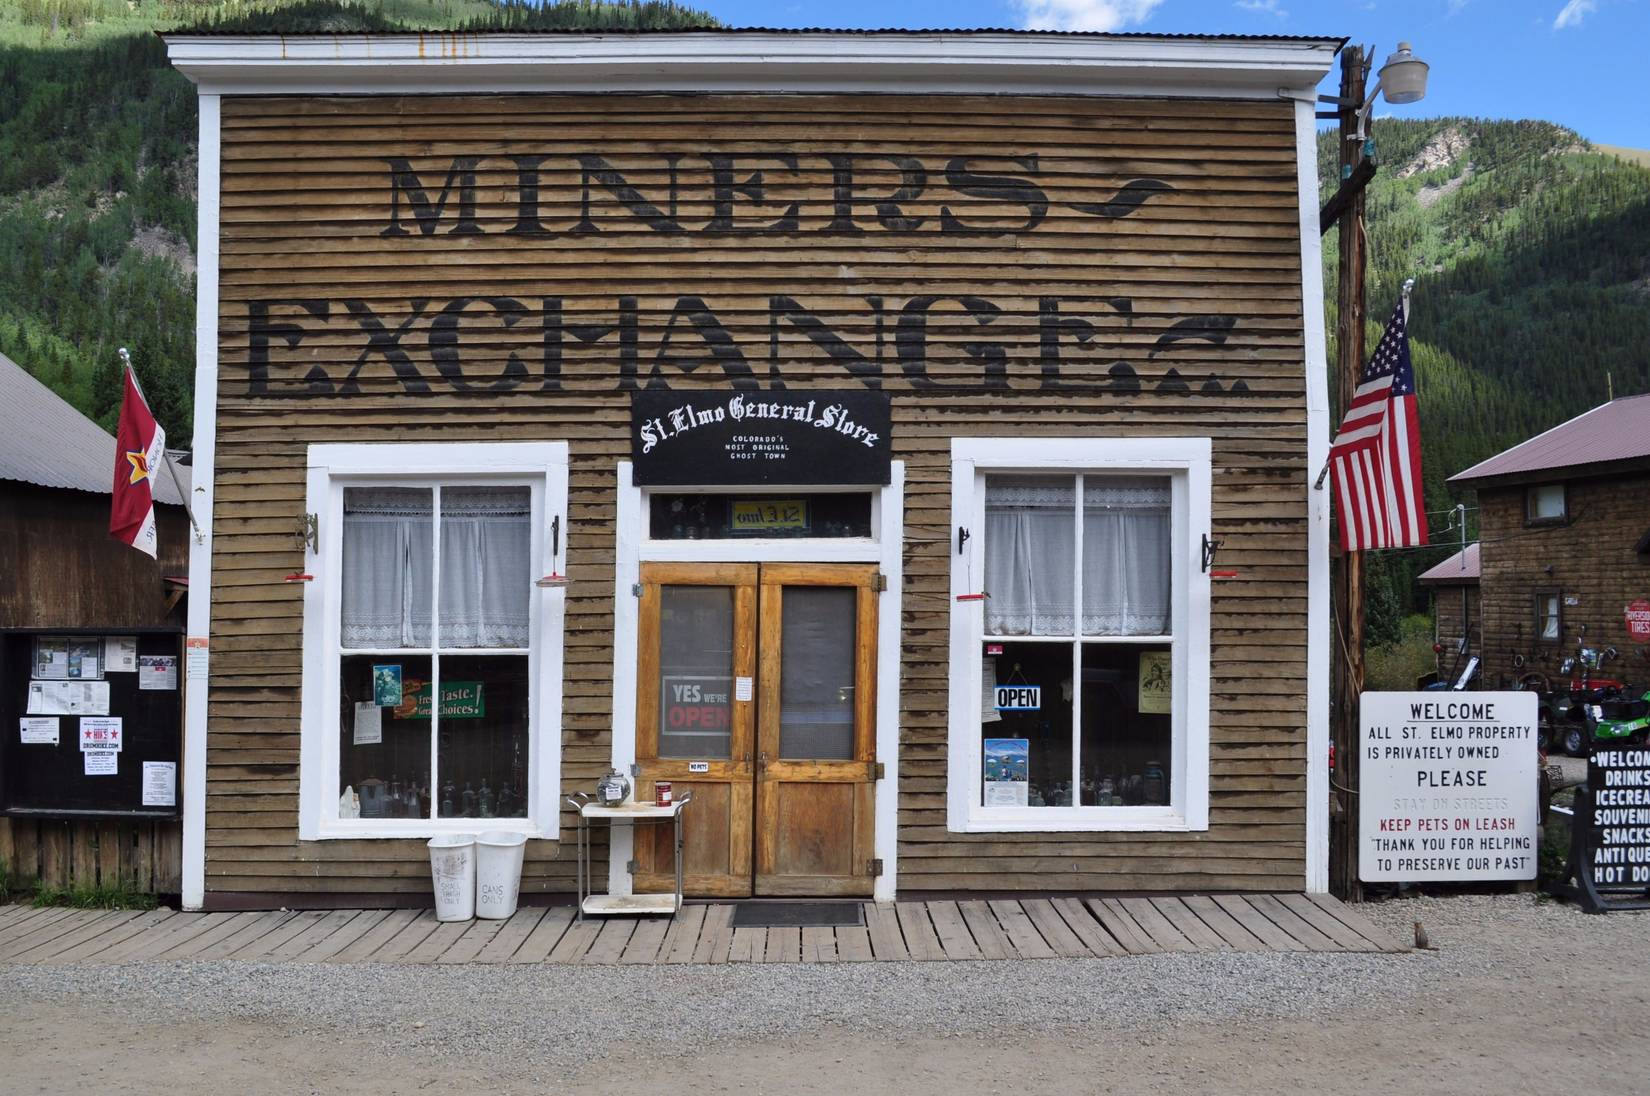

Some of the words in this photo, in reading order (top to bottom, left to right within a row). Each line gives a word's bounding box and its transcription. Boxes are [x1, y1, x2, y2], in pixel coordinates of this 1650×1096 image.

[379, 152, 1050, 236] MINERS
[247, 295, 1141, 396] EXCHANGE
[667, 404, 726, 438] Elmo
[728, 393, 816, 423] General
[813, 403, 880, 448] Store
[732, 435, 784, 443] COLORADO'S
[730, 452, 757, 460] GHOST
[764, 452, 786, 460] TOWN
[1631, 622, 1650, 633] TIRES
[672, 684, 702, 703] YES
[703, 693, 728, 703] WE'RE
[997, 688, 1038, 708] OPEN
[669, 706, 731, 728] OPEN
[1410, 703, 1496, 720] WELCOME
[1368, 727, 1392, 740] ALL
[1402, 727, 1422, 740] ST.
[1431, 727, 1463, 739] ELMO
[1469, 726, 1531, 739] PROPERTY
[1368, 747, 1379, 760] IS
[1385, 747, 1452, 760] PRIVATELY
[1458, 746, 1500, 759] OWNED
[1417, 770, 1488, 787] PLEASE
[1605, 770, 1650, 786] DRINKS
[1380, 819, 1412, 832] KEEP
[1418, 818, 1449, 831] PETS
[1454, 818, 1470, 831] ON
[1476, 818, 1516, 831] LEASH
[1594, 808, 1650, 825] SOUVENI
[1422, 838, 1445, 850] YOU
[1451, 838, 1474, 850] FOR
[1480, 837, 1531, 850] HELPING
[1377, 858, 1392, 871] TO
[1398, 858, 1461, 871] PRESERVE
[1467, 857, 1490, 870] OUR
[1594, 865, 1625, 883] HOT
[1632, 865, 1650, 882] DO
